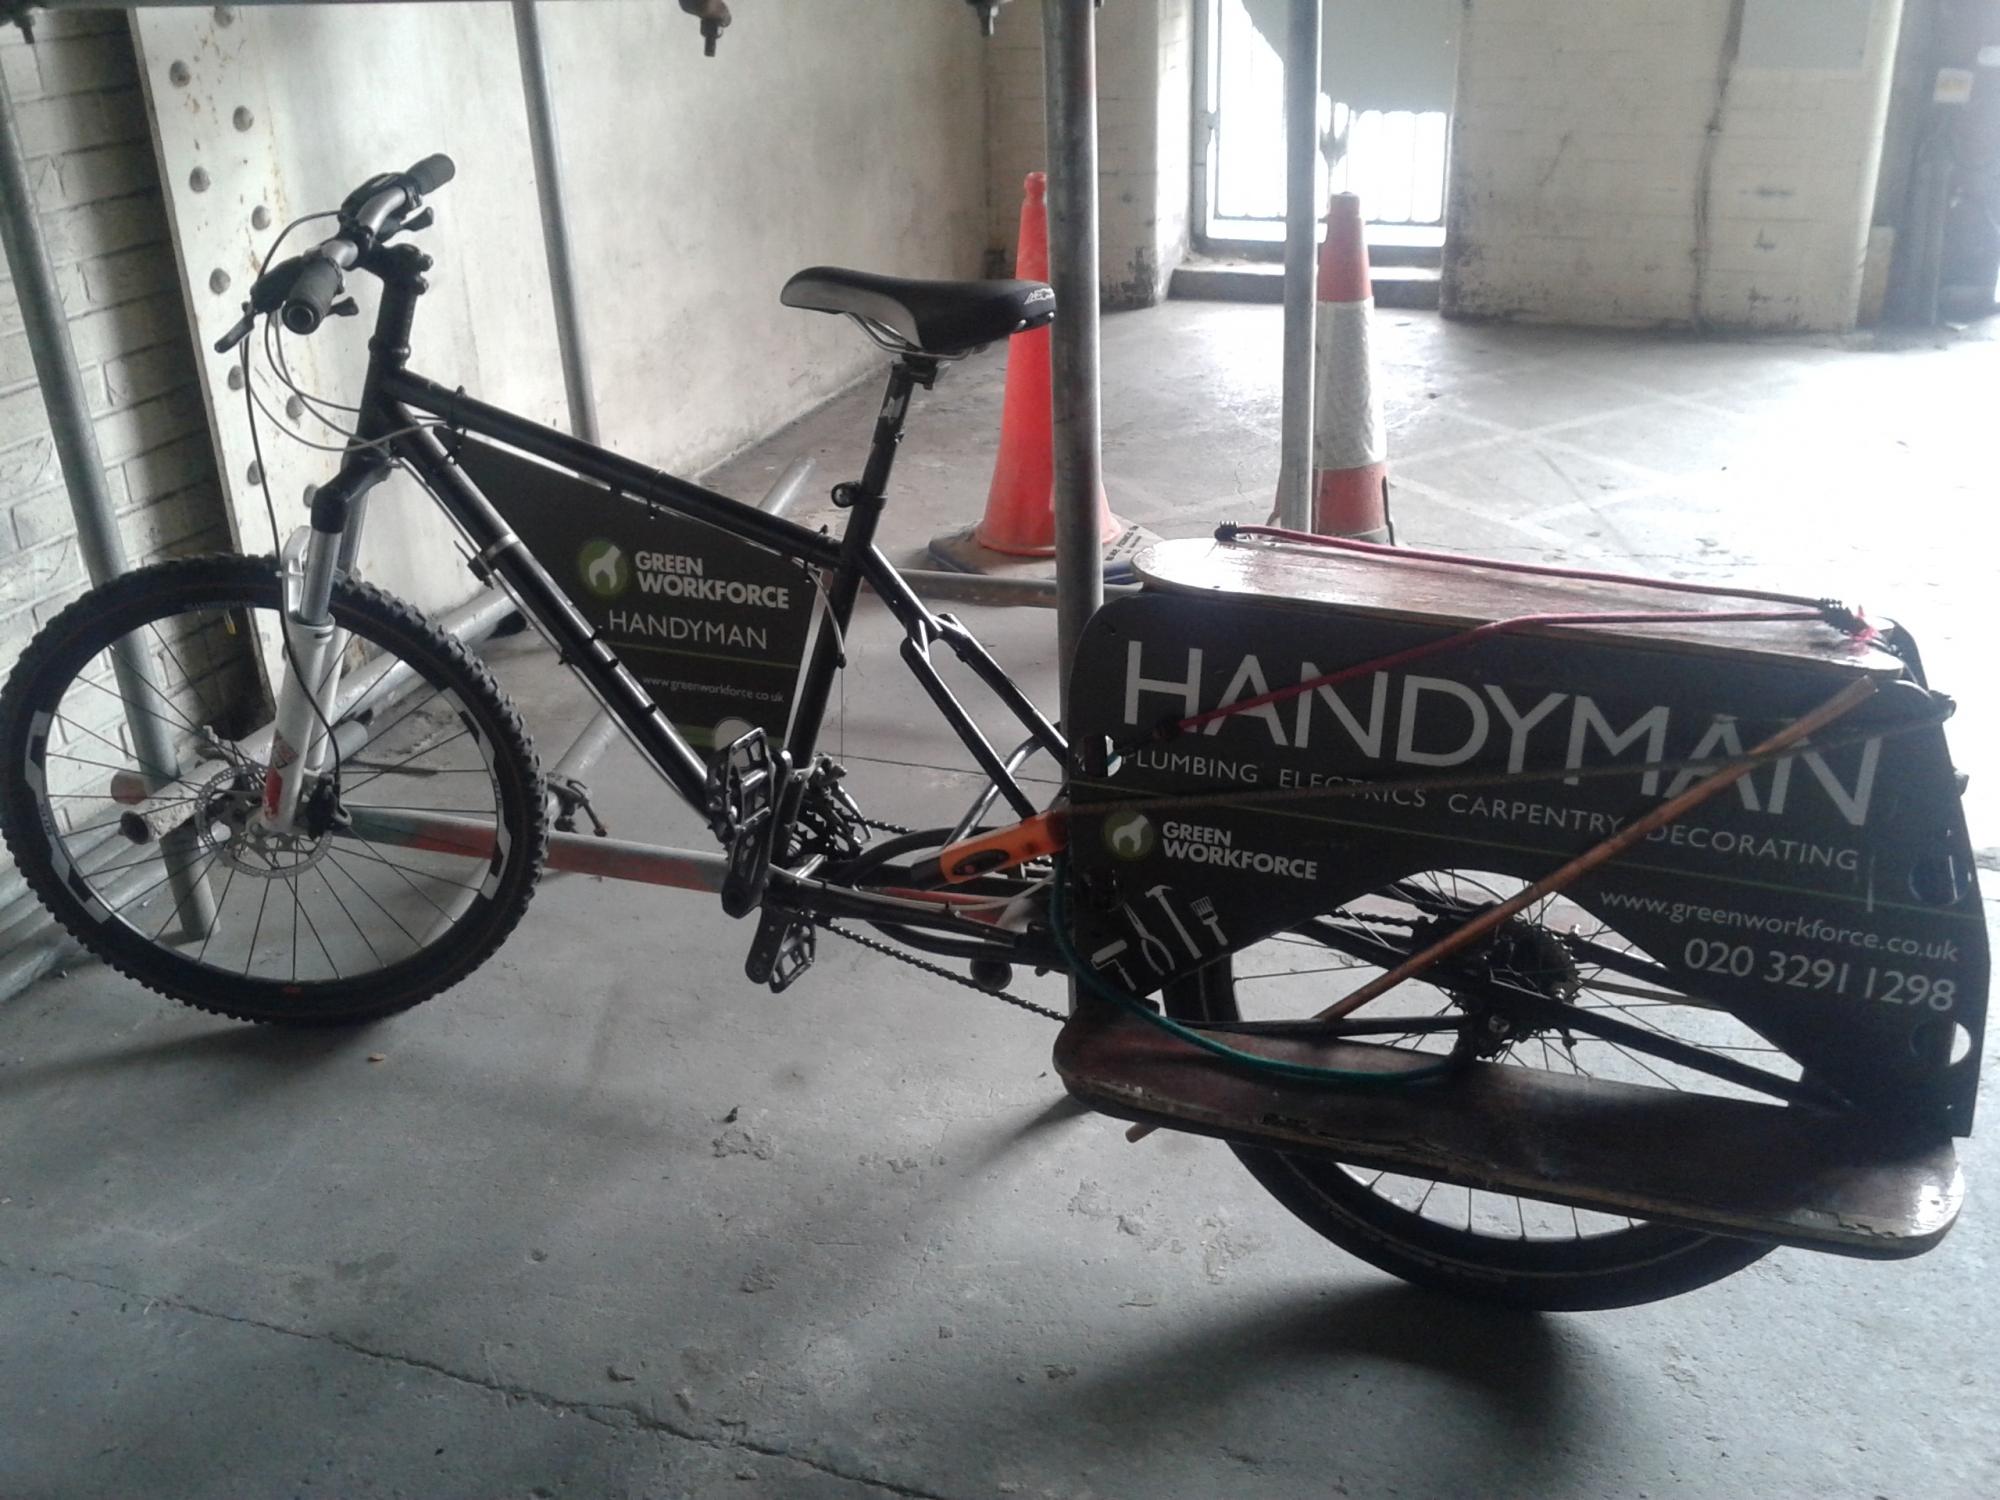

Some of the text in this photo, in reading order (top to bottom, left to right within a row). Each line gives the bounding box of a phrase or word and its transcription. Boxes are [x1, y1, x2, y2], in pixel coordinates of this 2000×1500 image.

[635, 551, 703, 577] GREEN
[637, 571, 789, 609] WORKFORCE
[608, 609, 768, 650] HANDYMAN
[642, 676, 785, 703] wwwgreenworkforcecouk
[1123, 639, 1883, 826] HANDYMAN
[1122, 749, 1860, 871] LUMBING ELECTICS CARPENTRY DECORATING
[1162, 821, 1232, 847] GREEN
[1162, 838, 1318, 880] WORKFORCE
[1600, 890, 1958, 962] www.greenworkforce.co.uk
[1684, 937, 1957, 1012] 020 3291 1298
